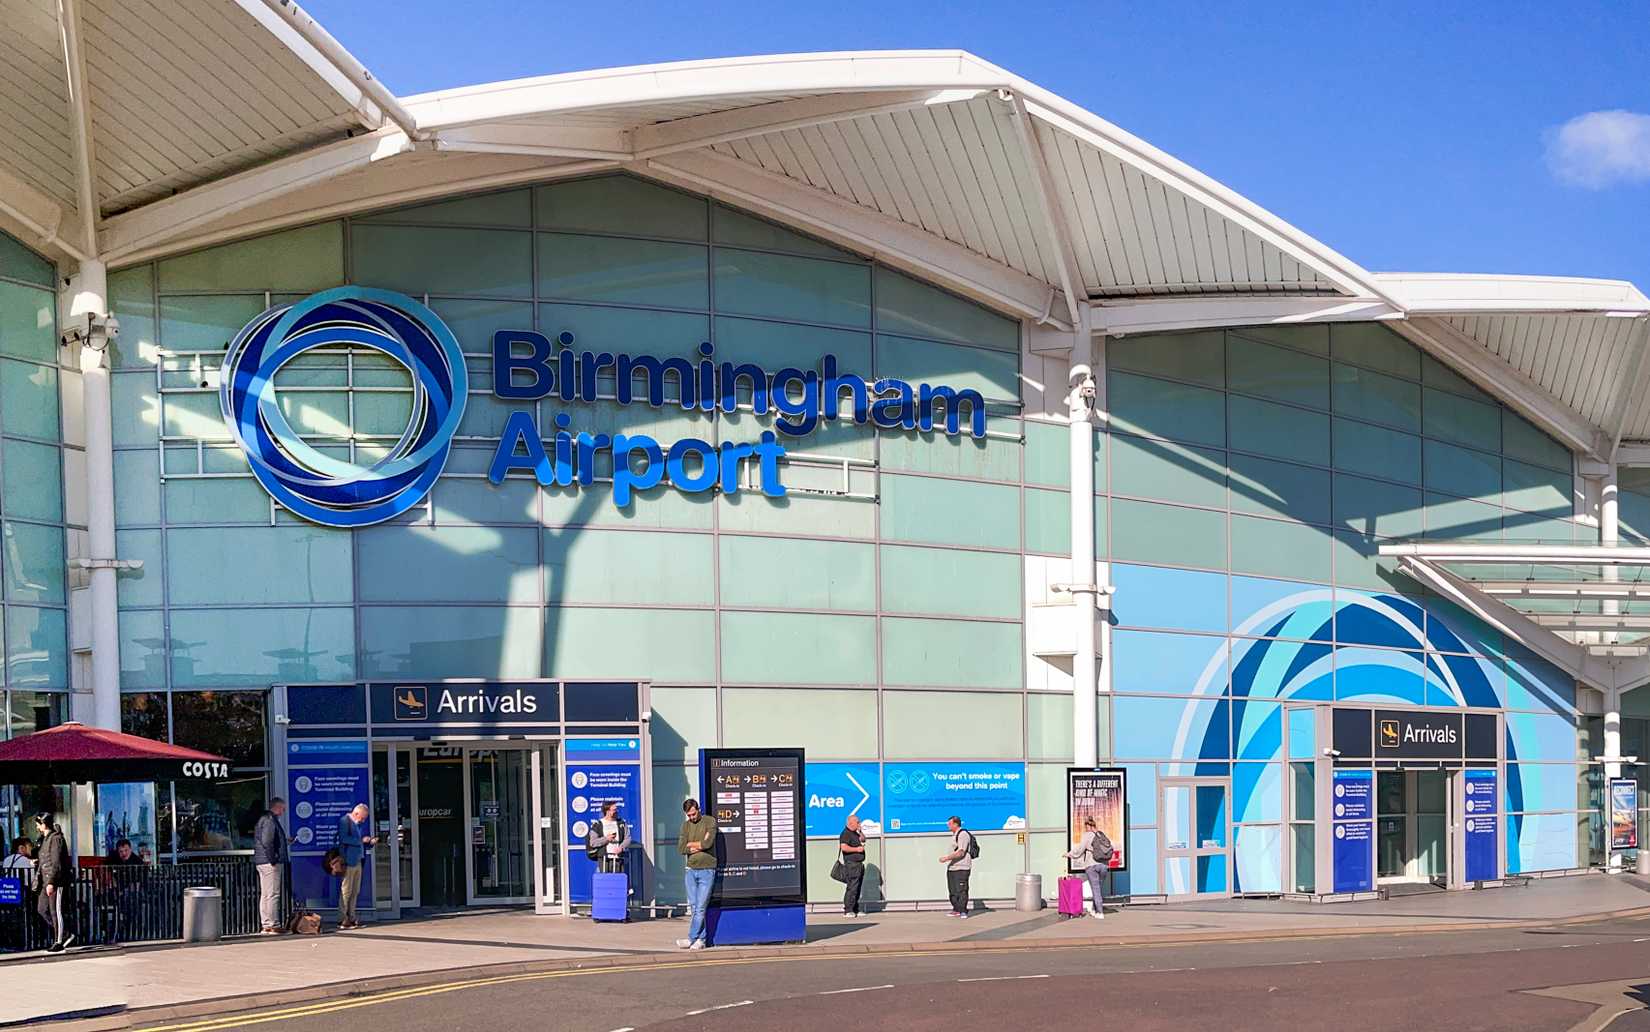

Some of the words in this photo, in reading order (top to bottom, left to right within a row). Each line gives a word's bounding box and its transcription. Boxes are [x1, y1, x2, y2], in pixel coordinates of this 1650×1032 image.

[492, 329, 986, 439] Birmingham
[489, 410, 786, 507] Airport
[437, 689, 537, 713] Arrivals
[1404, 723, 1457, 744] Arrivals
[720, 759, 759, 767] Information
[182, 761, 228, 778] COSTA
[726, 775, 733, 783] A
[752, 775, 759, 783] B
[779, 774, 785, 783] C
[932, 772, 948, 780] You
[949, 772, 967, 780] can't
[1003, 773, 1020, 781] vape
[945, 782, 973, 791] beyond
[989, 782, 1008, 790] point
[809, 794, 844, 808] Area
[418, 808, 451, 817] uropcar
[726, 810, 732, 818] D
